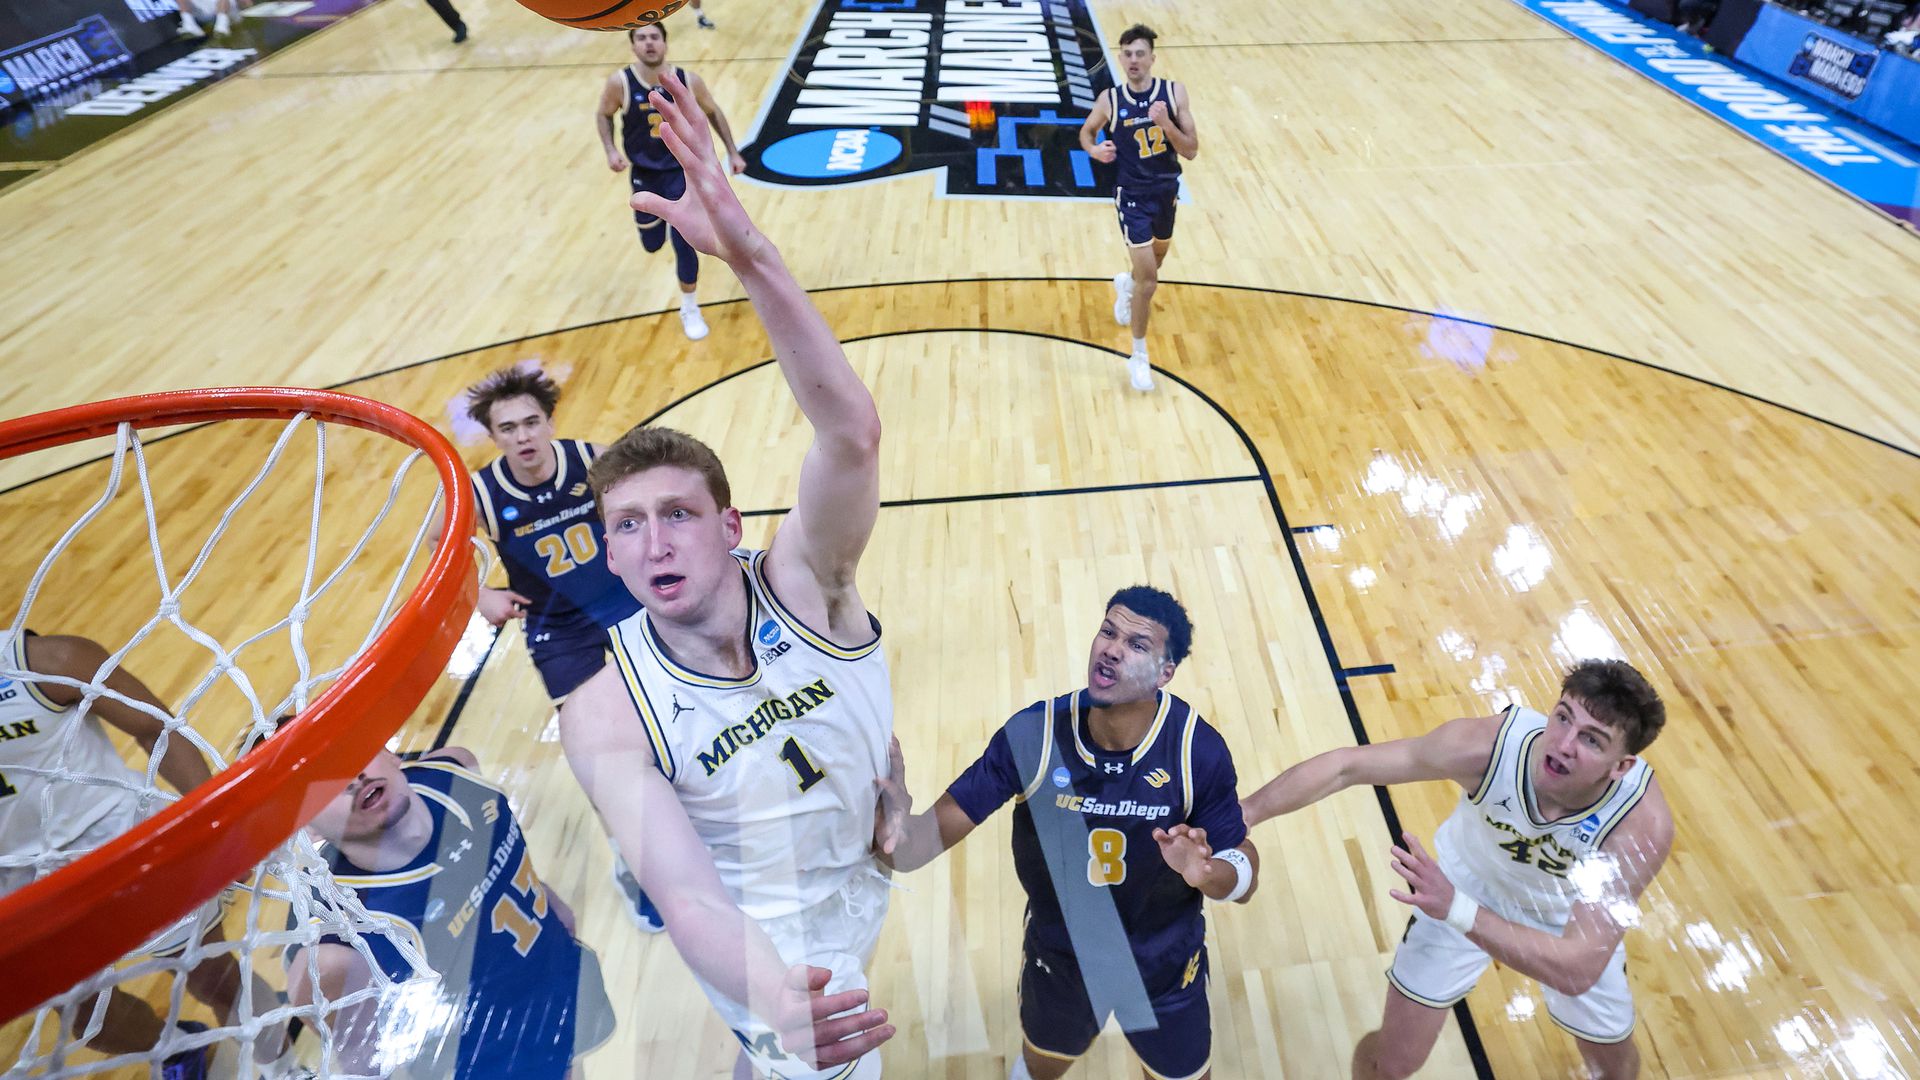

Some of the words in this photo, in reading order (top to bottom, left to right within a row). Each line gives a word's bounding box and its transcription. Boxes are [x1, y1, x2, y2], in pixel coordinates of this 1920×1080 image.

[2, 36, 93, 91] MARCH
[787, 12, 933, 126] MARCH
[937, 0, 1062, 103] MADNE
[1646, 58, 1830, 122] ROAD
[826, 129, 871, 170] NCAA
[1133, 125, 1167, 159] 12
[1763, 124, 1882, 166] THE
[534, 522, 599, 578] 20
[696, 677, 835, 777] MICHIGAN
[779, 736, 826, 794] 1
[1087, 828, 1127, 887] 8
